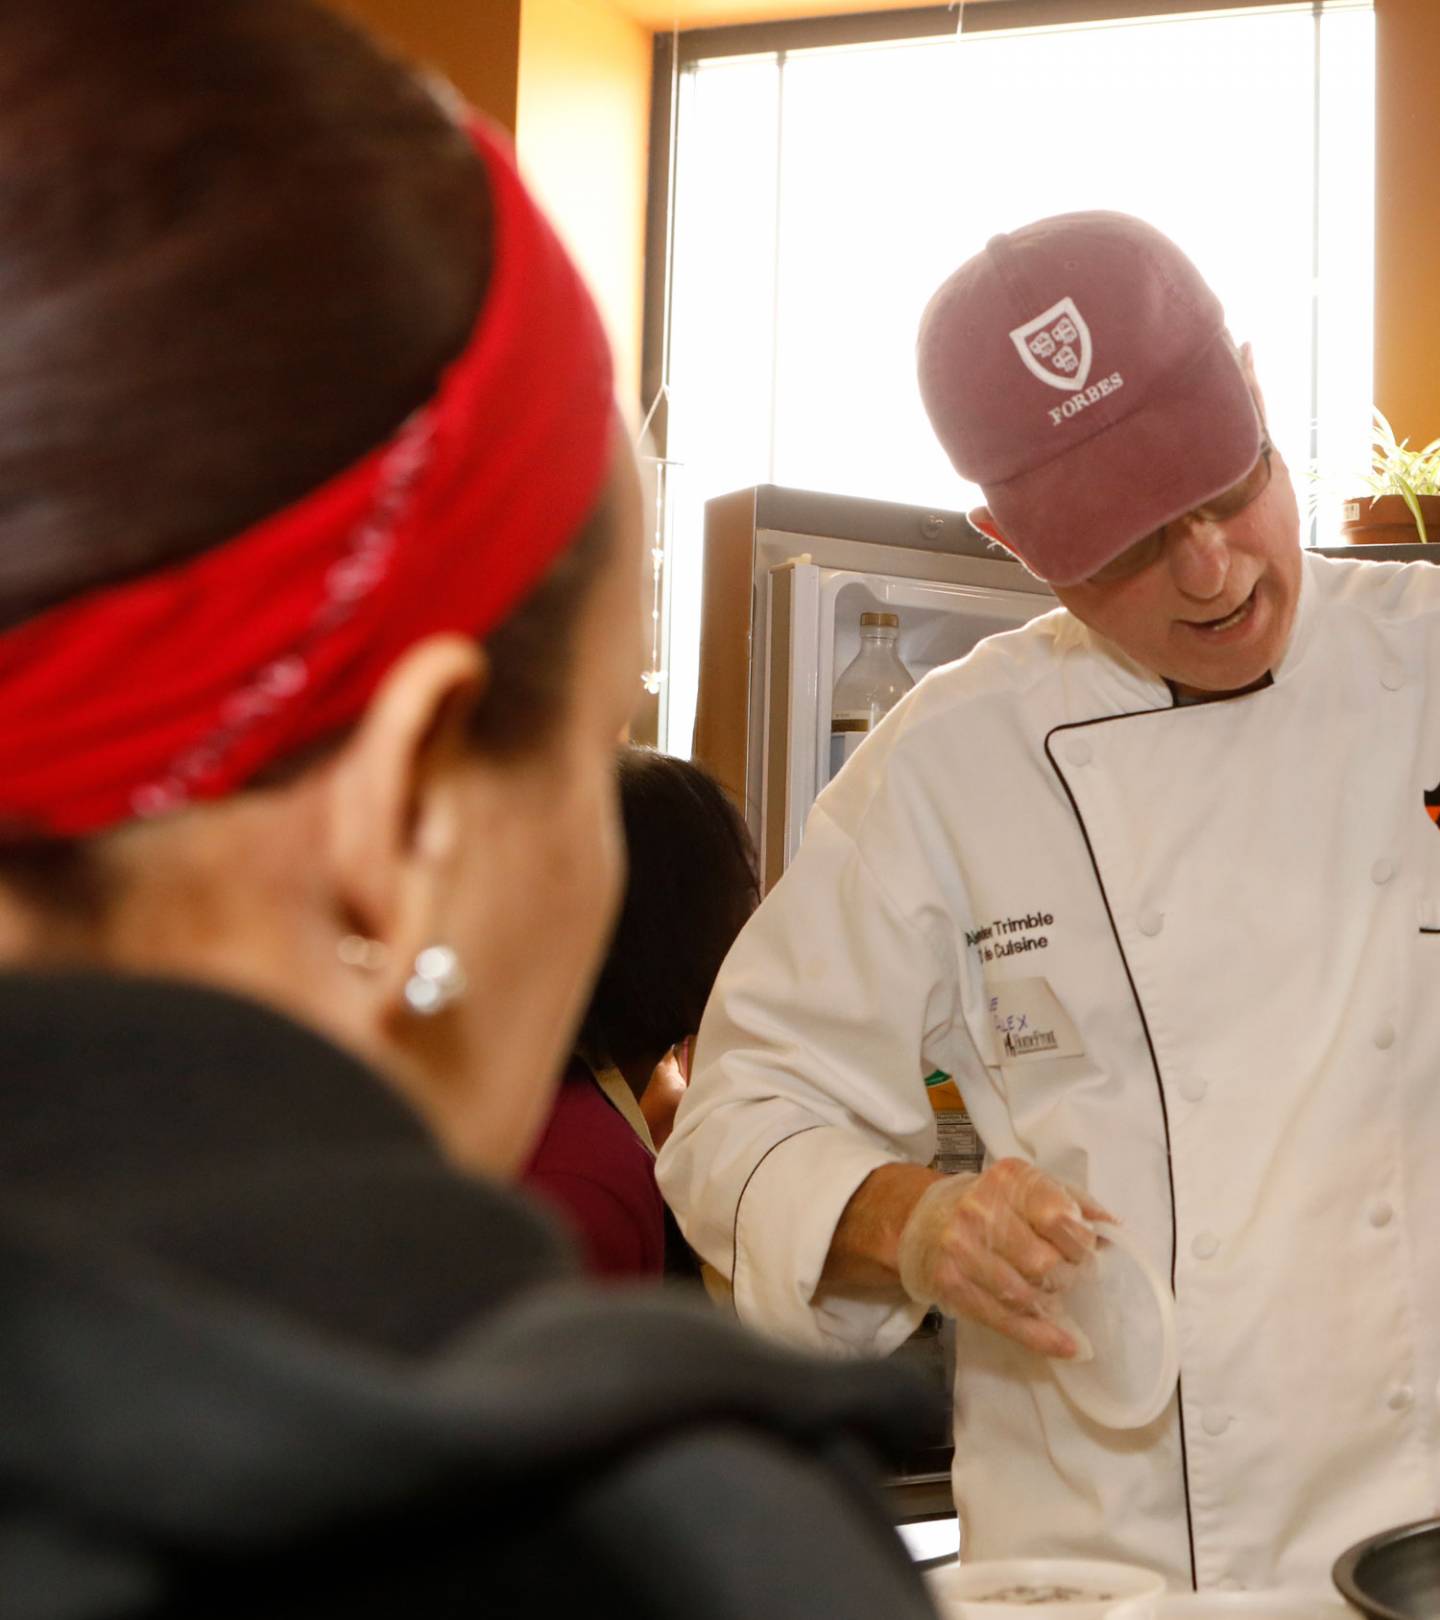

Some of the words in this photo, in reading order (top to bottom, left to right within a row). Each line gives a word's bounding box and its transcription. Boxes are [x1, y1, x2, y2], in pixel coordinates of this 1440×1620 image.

[1047, 371, 1124, 427] FORBES
[993, 912, 1054, 936] Trimble
[994, 936, 1048, 958] Cuisine
